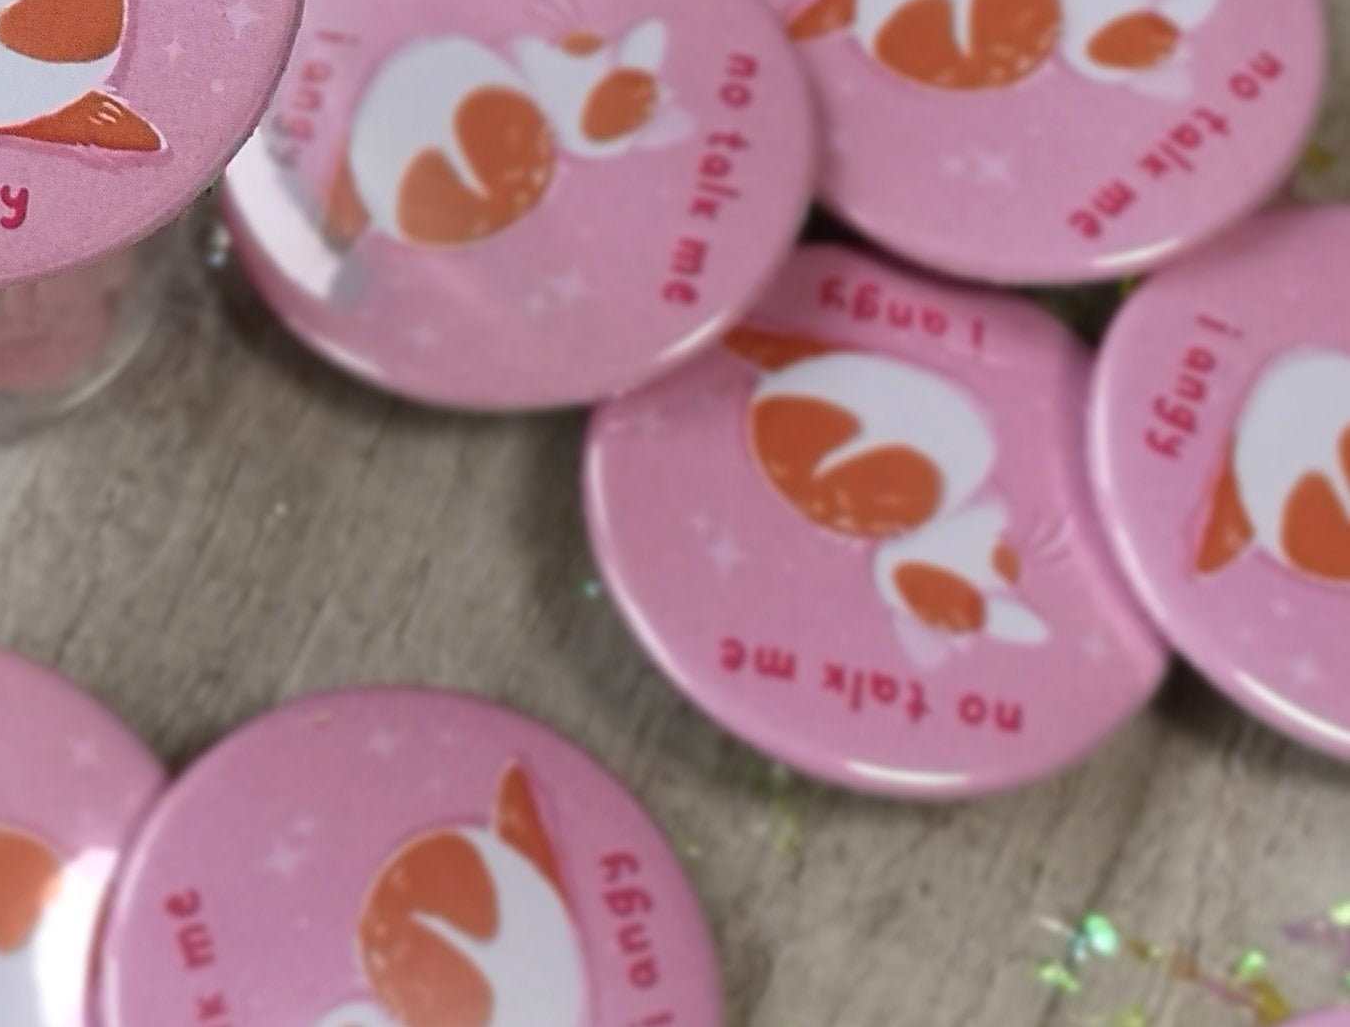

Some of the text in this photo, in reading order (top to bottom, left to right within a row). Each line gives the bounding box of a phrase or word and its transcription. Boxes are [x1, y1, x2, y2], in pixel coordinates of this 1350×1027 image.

[662, 54, 758, 306] no talk me
[1066, 51, 1282, 238] no talk me
[819, 280, 949, 338] angy
[1145, 346, 1217, 460] angy
[719, 638, 1024, 734] no talk me
[165, 889, 216, 971] me
[598, 851, 660, 990] angy
